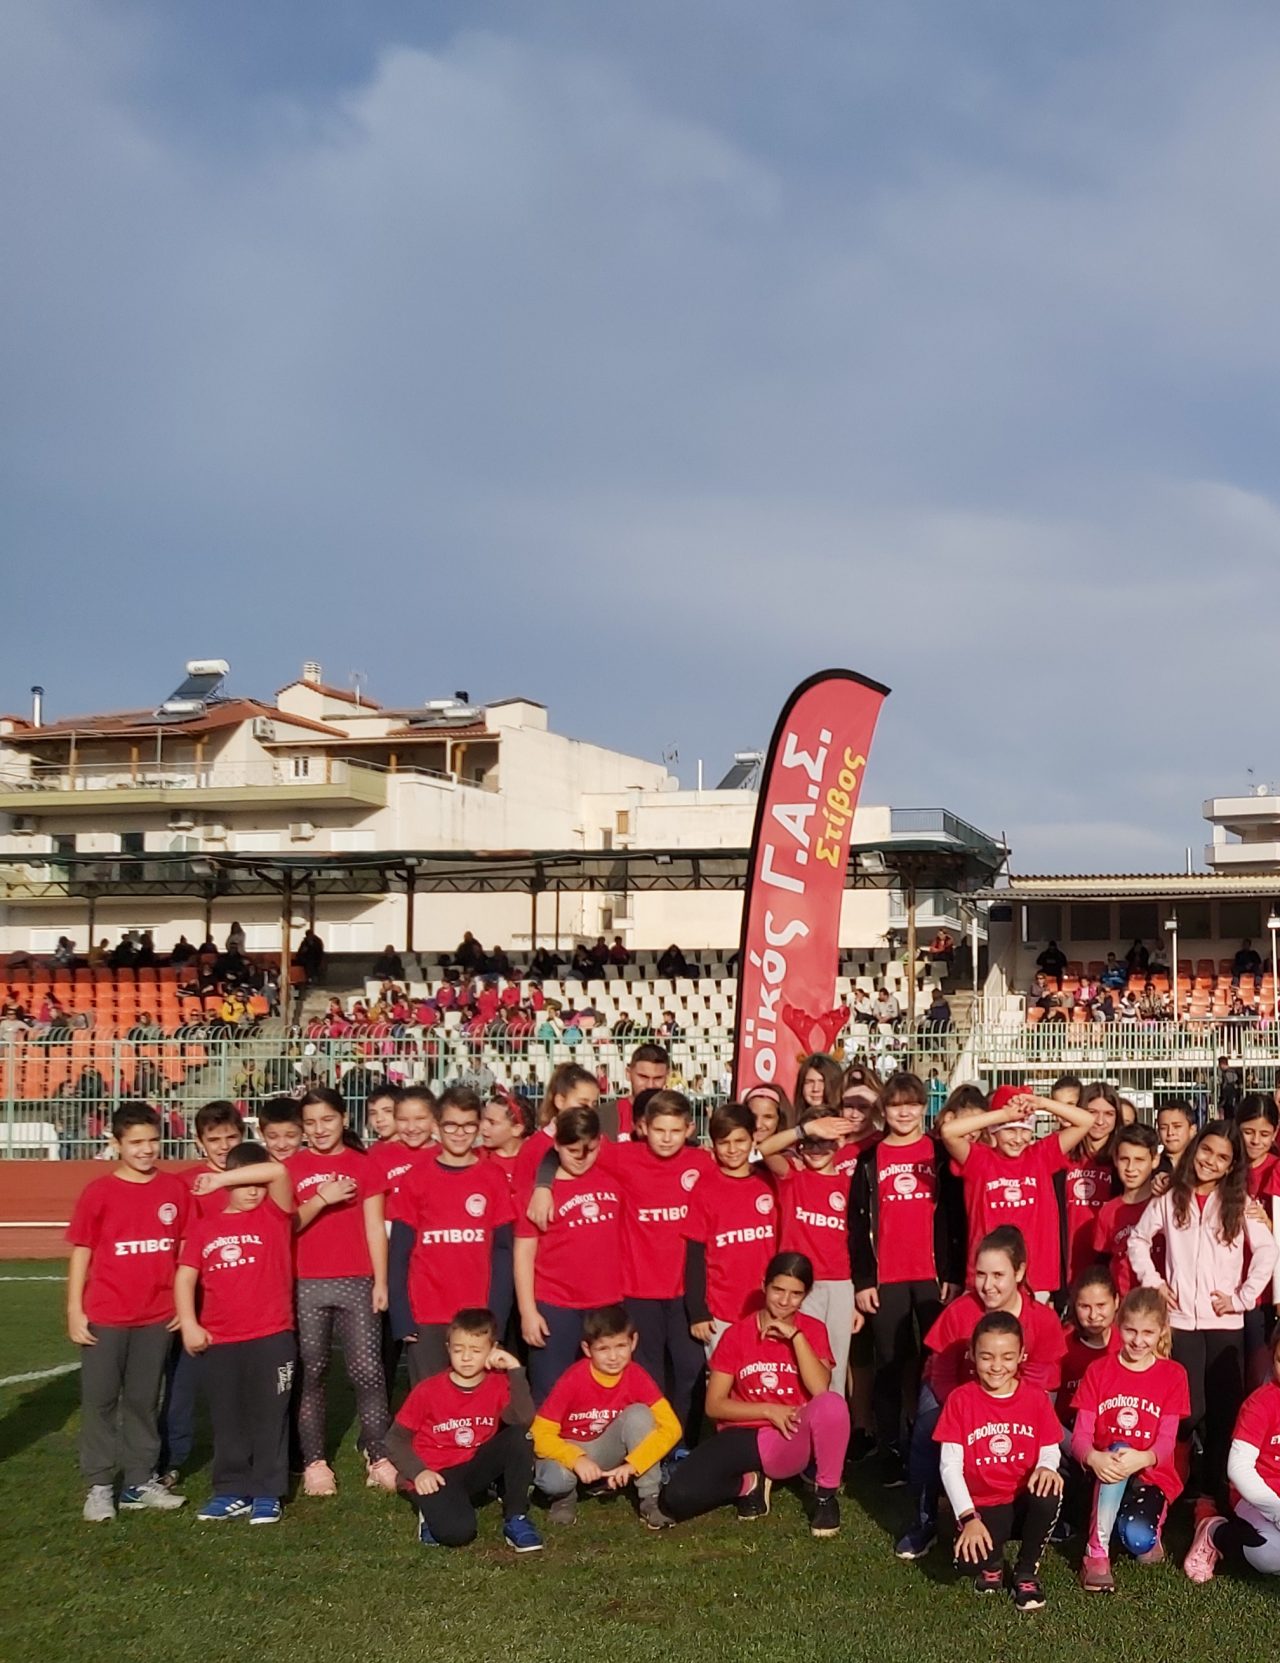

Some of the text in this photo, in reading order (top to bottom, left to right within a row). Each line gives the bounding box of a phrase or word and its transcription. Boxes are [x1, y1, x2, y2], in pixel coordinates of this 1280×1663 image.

[815, 745, 866, 869] Στίβος
[741, 727, 833, 1100] οϊκός Γ.Α.Σ.
[878, 1163, 914, 1183] ΒΟΪΚΟΣ
[638, 1204, 689, 1222] ΣΤΙΒΟ
[795, 1206, 846, 1231] ΣΤΙΒΟΣ
[114, 1237, 175, 1256] ΣΤΙΒΟ
[422, 1228, 485, 1245] ΣΤΙΒΟΣ
[715, 1224, 775, 1248] ΣΤΙΒΟΣ
[1098, 1393, 1140, 1416] ΕΥΒΟΪΚΟΣ
[432, 1416, 472, 1435] ΕΥΒΟΪΚΟΣ
[967, 1421, 1010, 1446] ΕΥΒΟΪΚΟΣ
[1108, 1424, 1152, 1440] ΤΙΒΟΣ
